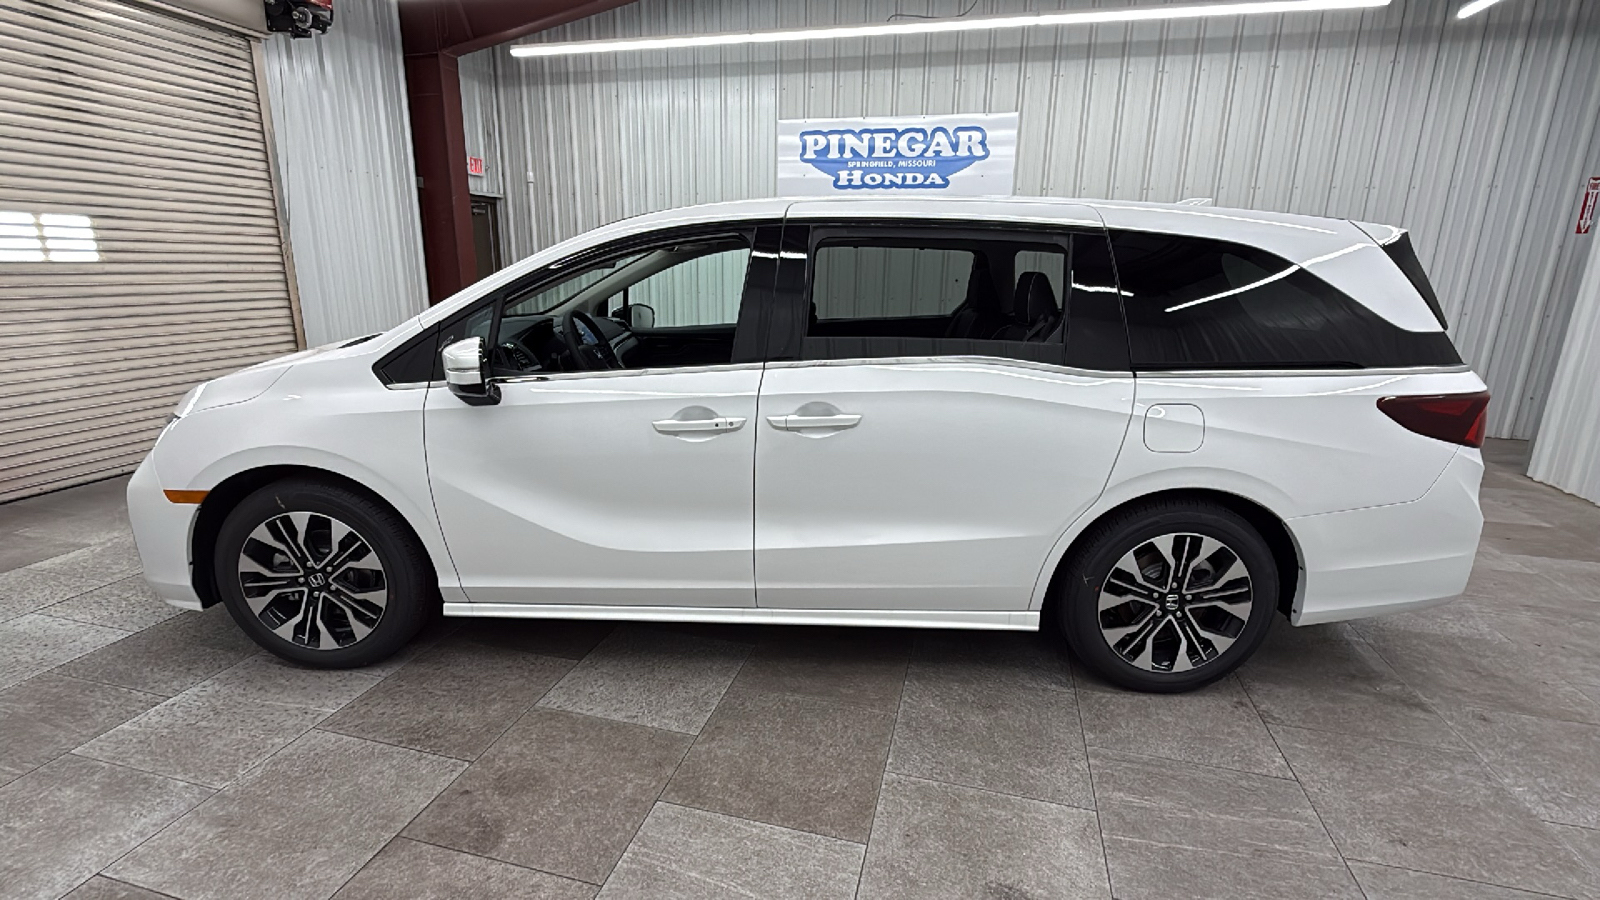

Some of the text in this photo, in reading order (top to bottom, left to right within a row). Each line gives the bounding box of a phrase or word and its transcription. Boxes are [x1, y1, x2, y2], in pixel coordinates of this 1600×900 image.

[803, 130, 986, 159] PINEGAR
[469, 157, 482, 173] EXIT
[847, 159, 936, 168] SPRINGFIELD, MISSOURI
[837, 169, 945, 186] HONDA
